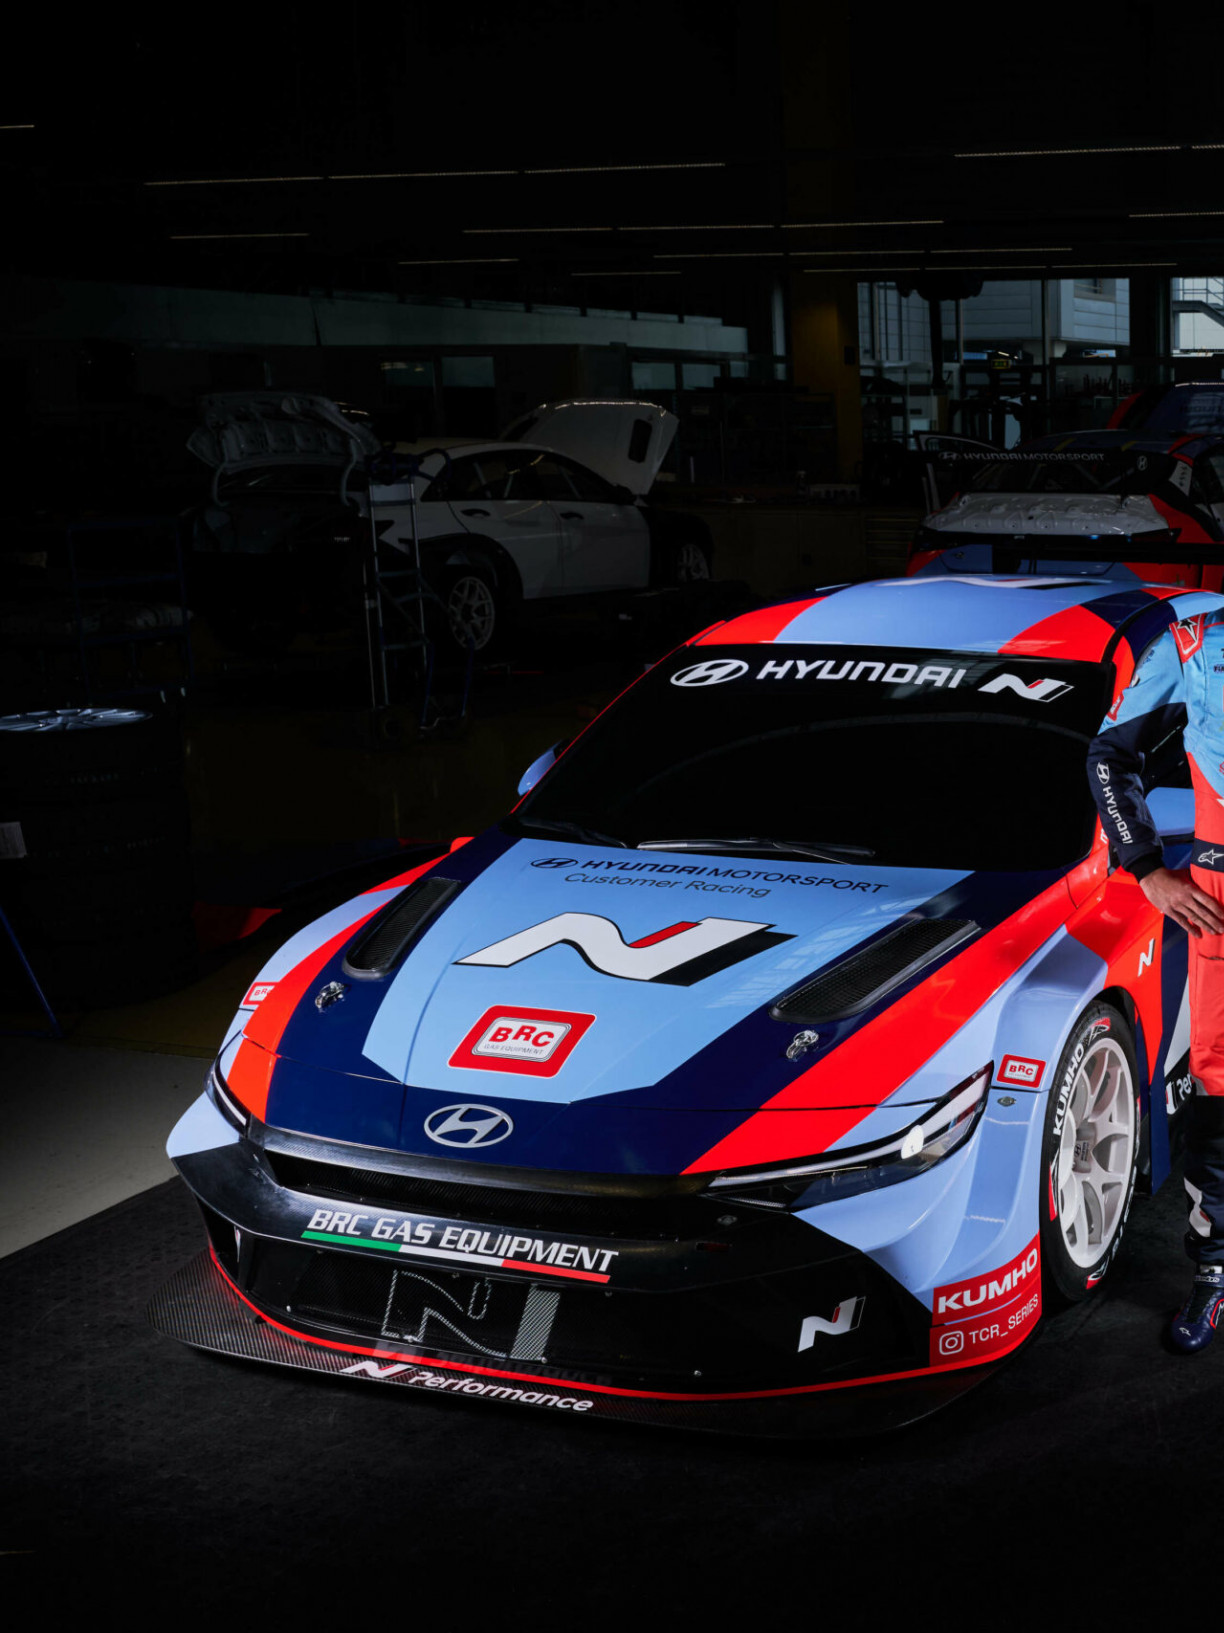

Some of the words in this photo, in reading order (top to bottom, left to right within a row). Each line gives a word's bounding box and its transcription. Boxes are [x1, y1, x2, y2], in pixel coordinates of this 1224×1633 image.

[755, 659, 966, 688] HYUNDAI
[1103, 786, 1133, 844] HYUNDAI
[564, 872, 683, 890] Customer
[688, 880, 771, 899] Racing
[581, 860, 709, 876] HYUNDAI
[708, 867, 889, 894] MOTORSPORT
[488, 1025, 555, 1047] BRC
[500, 1045, 544, 1055] EQUIPMENT
[1009, 1064, 1034, 1076] BRC
[1052, 1043, 1085, 1137] KUMHO
[307, 1208, 370, 1236] BRC
[371, 1217, 435, 1245] GAS
[438, 1226, 619, 1273] EQUIPMENT
[937, 1248, 1038, 1314] KUMHO
[969, 1293, 1039, 1345] TCR_SERIES
[408, 1371, 594, 1411] Performance
